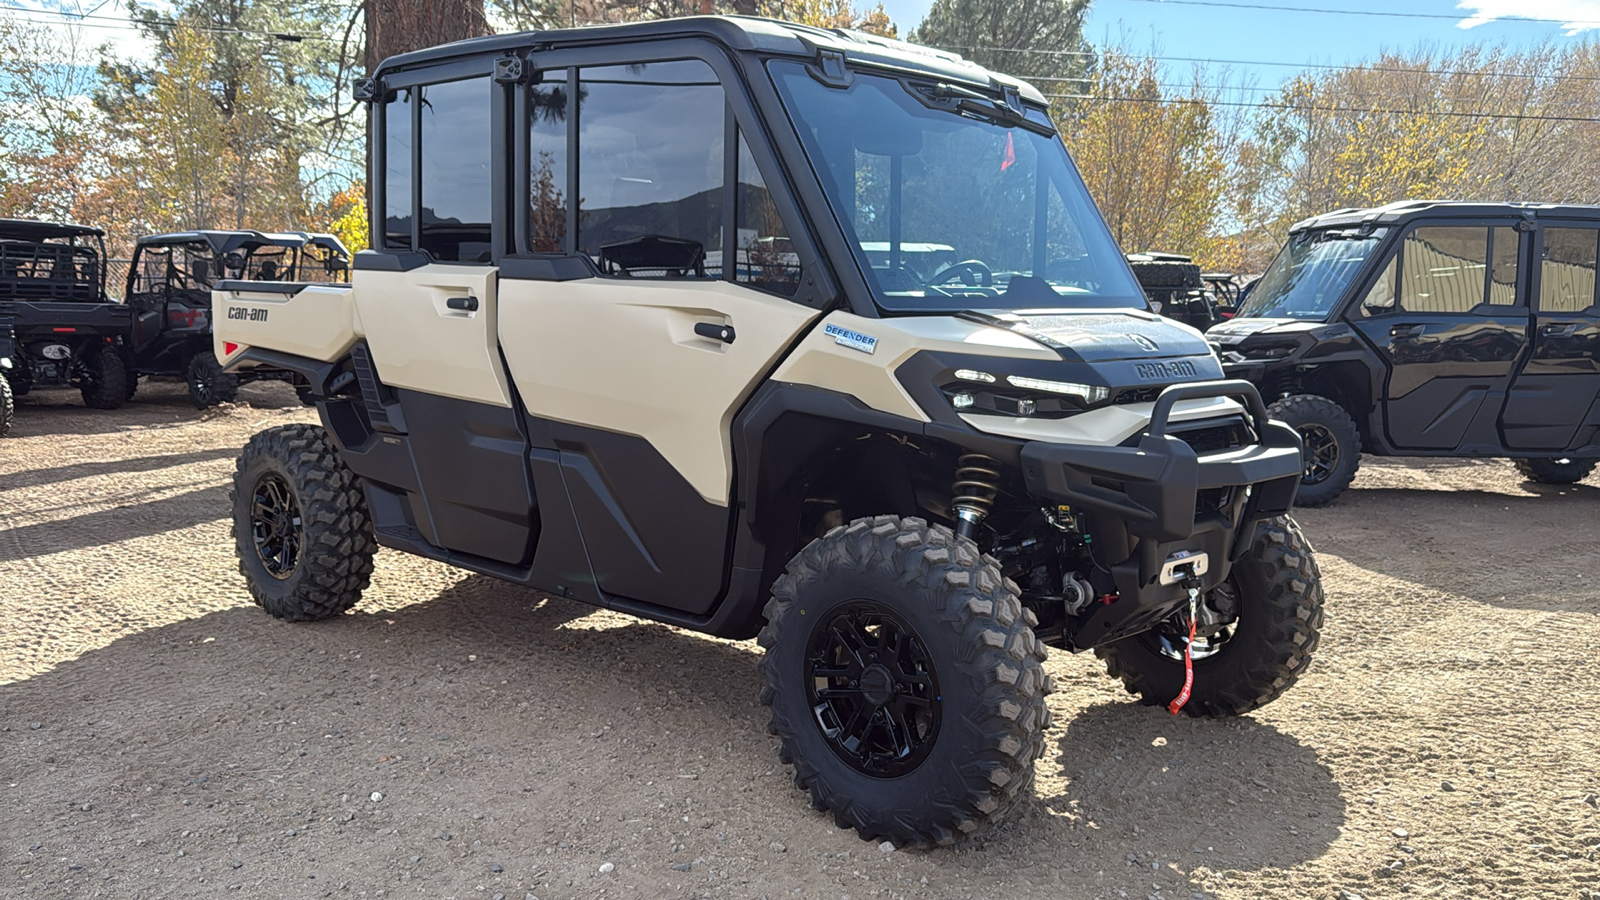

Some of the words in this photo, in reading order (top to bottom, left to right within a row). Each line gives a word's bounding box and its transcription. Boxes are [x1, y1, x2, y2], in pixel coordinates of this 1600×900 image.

[228, 307, 268, 321] can-am
[825, 325, 875, 345] DEFENDER
[1134, 360, 1198, 378] can-am
